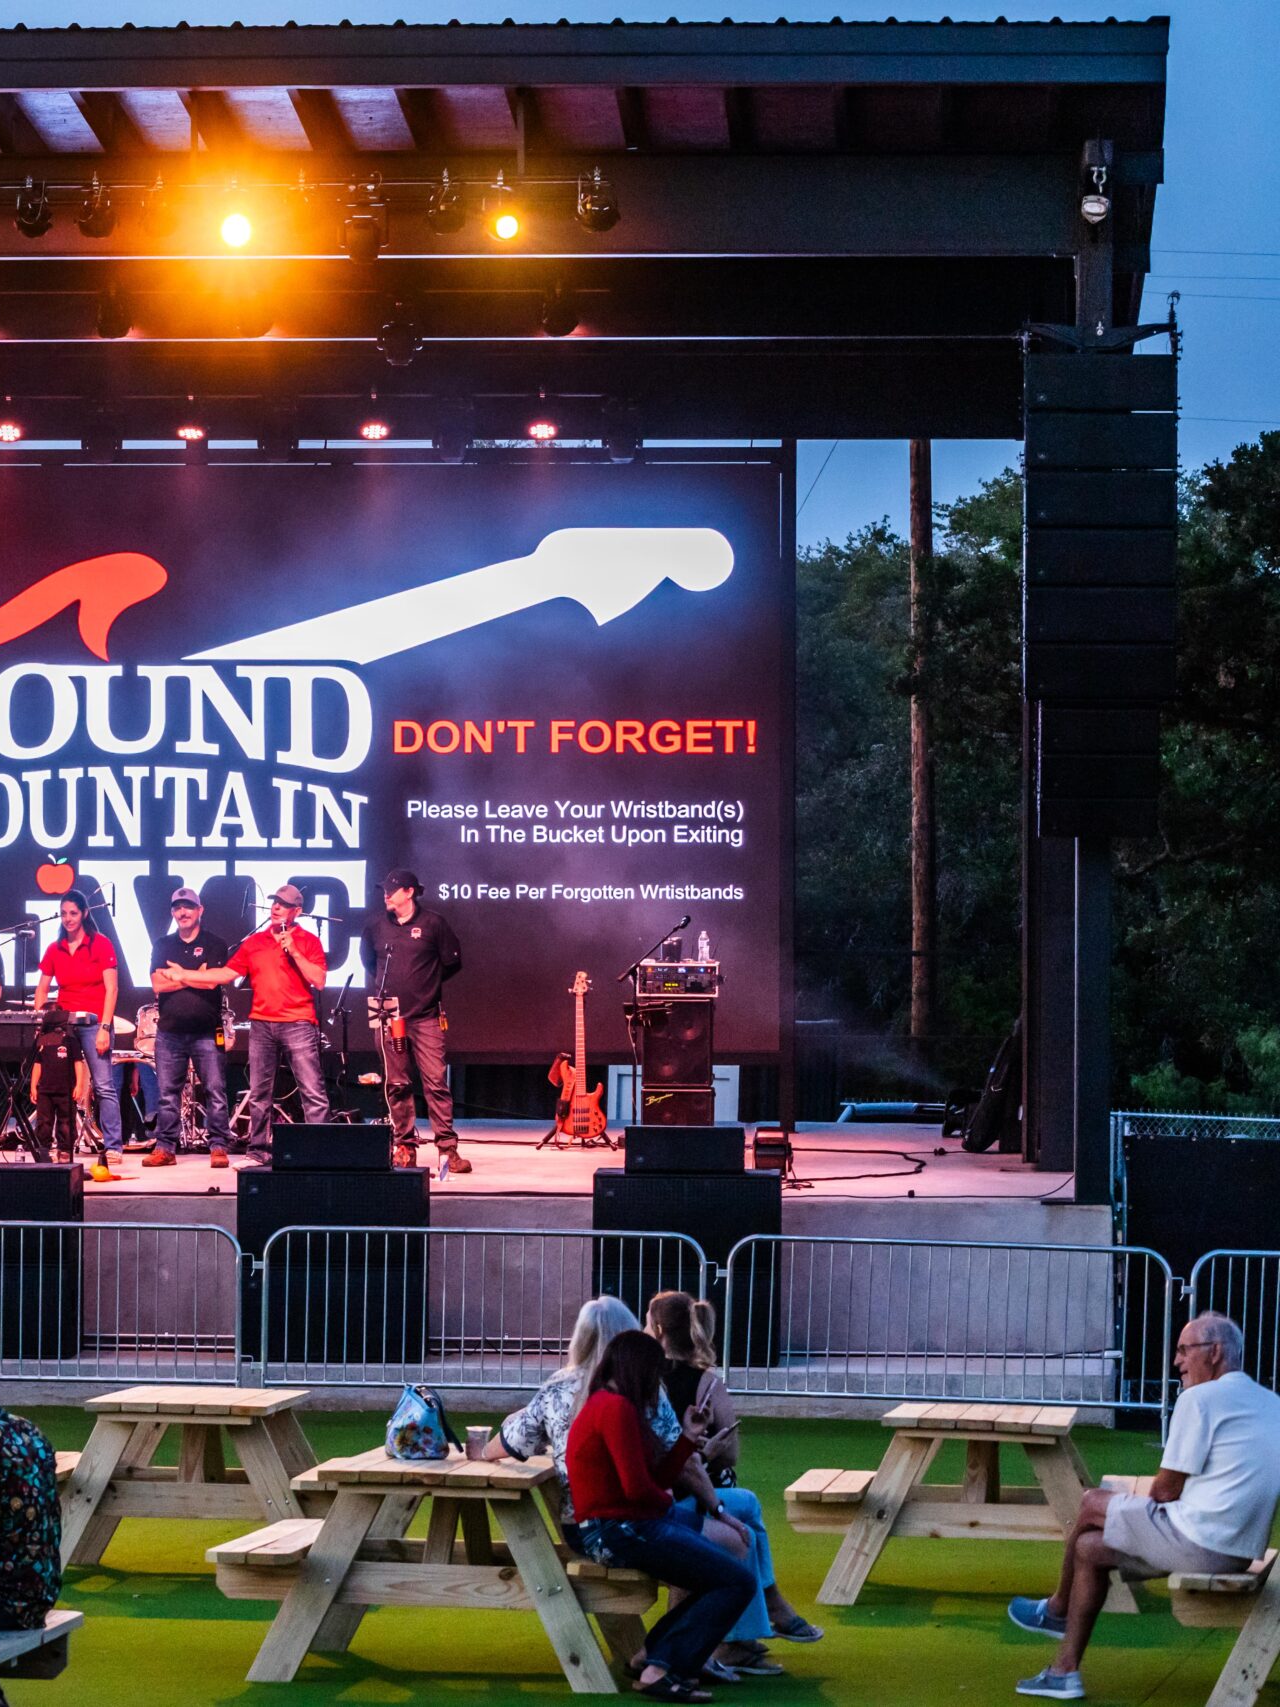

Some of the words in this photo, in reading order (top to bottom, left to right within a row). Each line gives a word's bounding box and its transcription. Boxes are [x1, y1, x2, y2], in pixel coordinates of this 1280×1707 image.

[393, 719, 536, 755] DON'T
[549, 719, 757, 755] FORGET!
[407, 800, 479, 819] Please
[484, 800, 549, 819] Leave
[554, 800, 606, 819] Your
[610, 800, 744, 822] Wristband(s)
[460, 824, 479, 843] In
[485, 824, 527, 844] The
[532, 824, 605, 844] Bucket
[611, 824, 667, 848] Upon
[673, 824, 743, 848] Exiting
[438, 883, 472, 901] $10
[477, 884, 511, 900] Fee
[515, 884, 547, 900] Per
[551, 883, 635, 903] Forgotten
[639, 883, 744, 900] Wrtistbands
